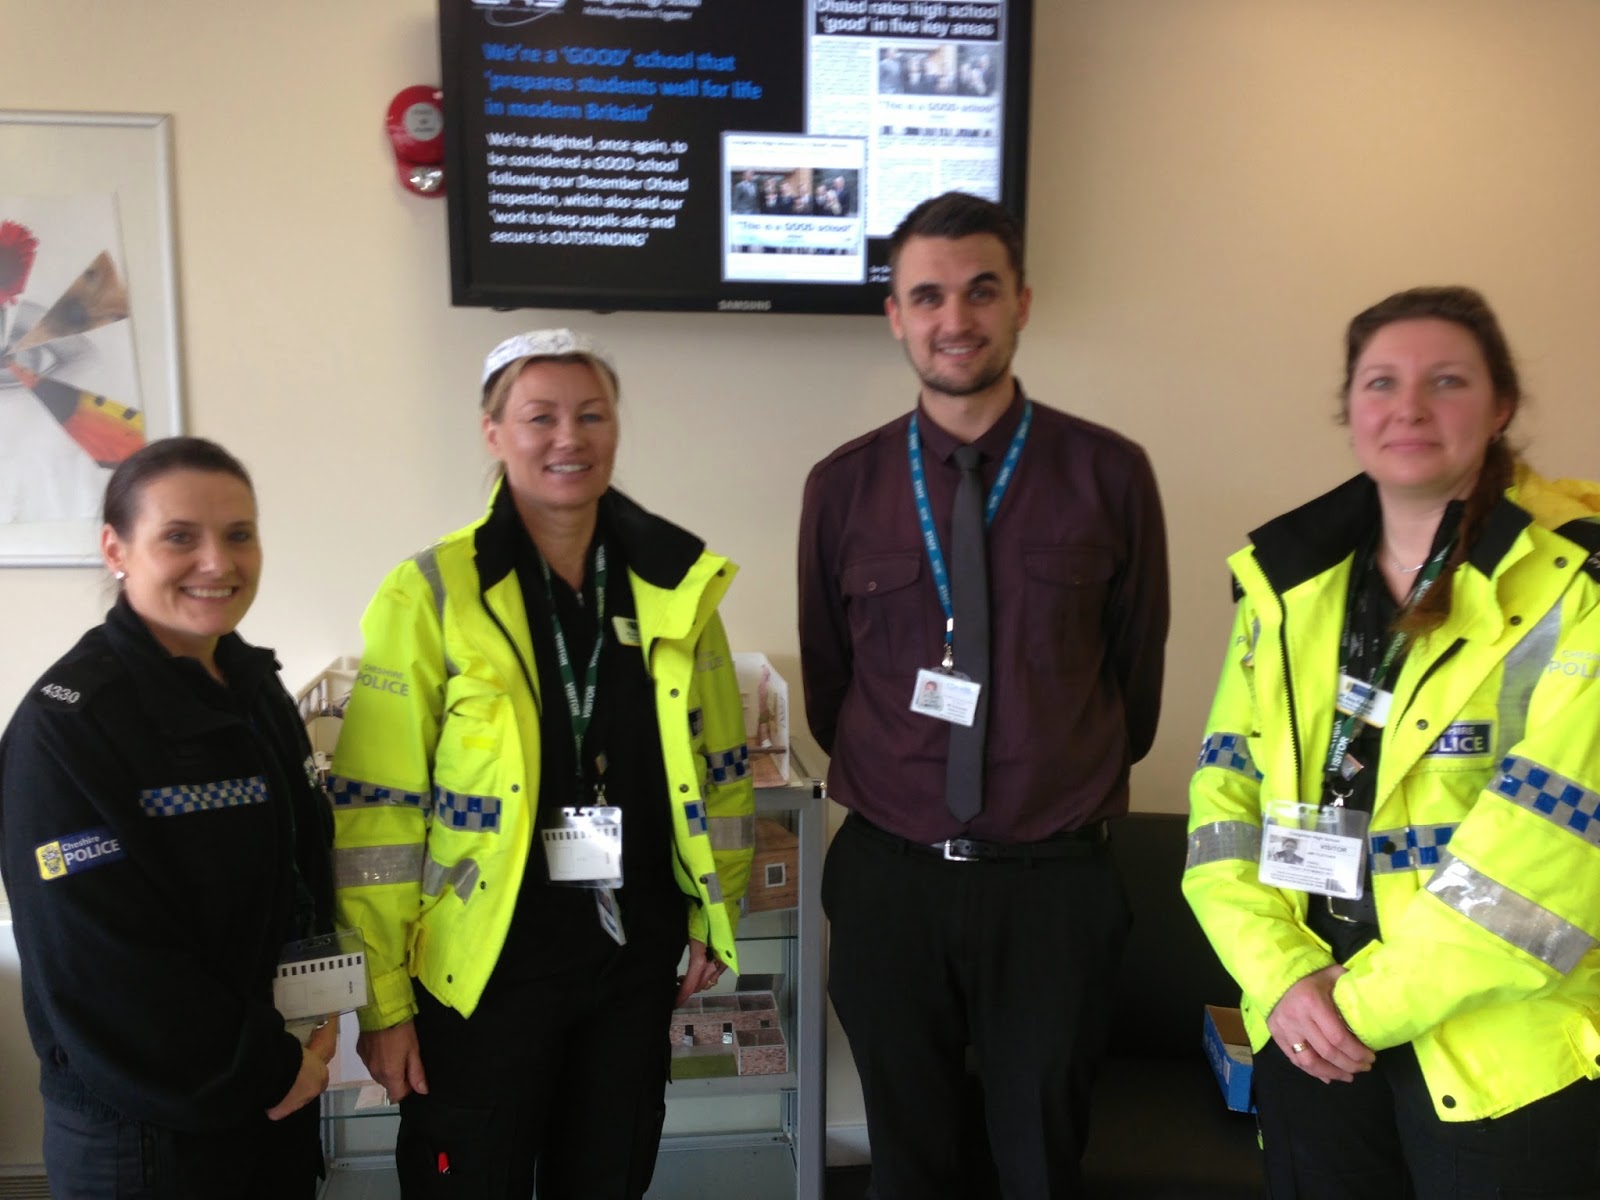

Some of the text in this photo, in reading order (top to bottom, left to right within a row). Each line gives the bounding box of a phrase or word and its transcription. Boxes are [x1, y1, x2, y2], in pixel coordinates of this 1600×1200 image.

[869, 1, 909, 14] rates
[909, 2, 947, 20] high
[870, 17, 888, 32] in
[889, 17, 920, 33] five
[920, 19, 950, 37] key
[950, 22, 995, 36] areas
[543, 50, 558, 63] a
[633, 51, 694, 69] school
[696, 52, 736, 71] that
[576, 75, 657, 95] students
[659, 79, 698, 96] well
[700, 79, 730, 97] for
[732, 80, 763, 99] life
[484, 98, 504, 116] in
[507, 99, 582, 119] modern
[486, 132, 688, 155] We're delighted, once again, to
[486, 151, 679, 172] be considered a GOOD school
[487, 170, 689, 192] following our December Ofsted
[488, 190, 685, 210] inspection, which also said our
[529, 212, 546, 224] to
[545, 211, 580, 228] keep
[579, 212, 620, 229] pupils
[620, 213, 649, 228] safe
[649, 214, 676, 228] and
[489, 230, 536, 244] secure
[536, 230, 549, 244] is
[718, 300, 771, 311] SAMSUNG
[555, 632, 569, 667] VISITOR
[40, 683, 81, 704] 4330
[564, 682, 580, 716] VISITOR
[581, 685, 596, 719] VISITOR
[1429, 736, 1483, 752] LICE
[62, 835, 100, 851] Cheshire
[65, 839, 121, 865] POLICE
